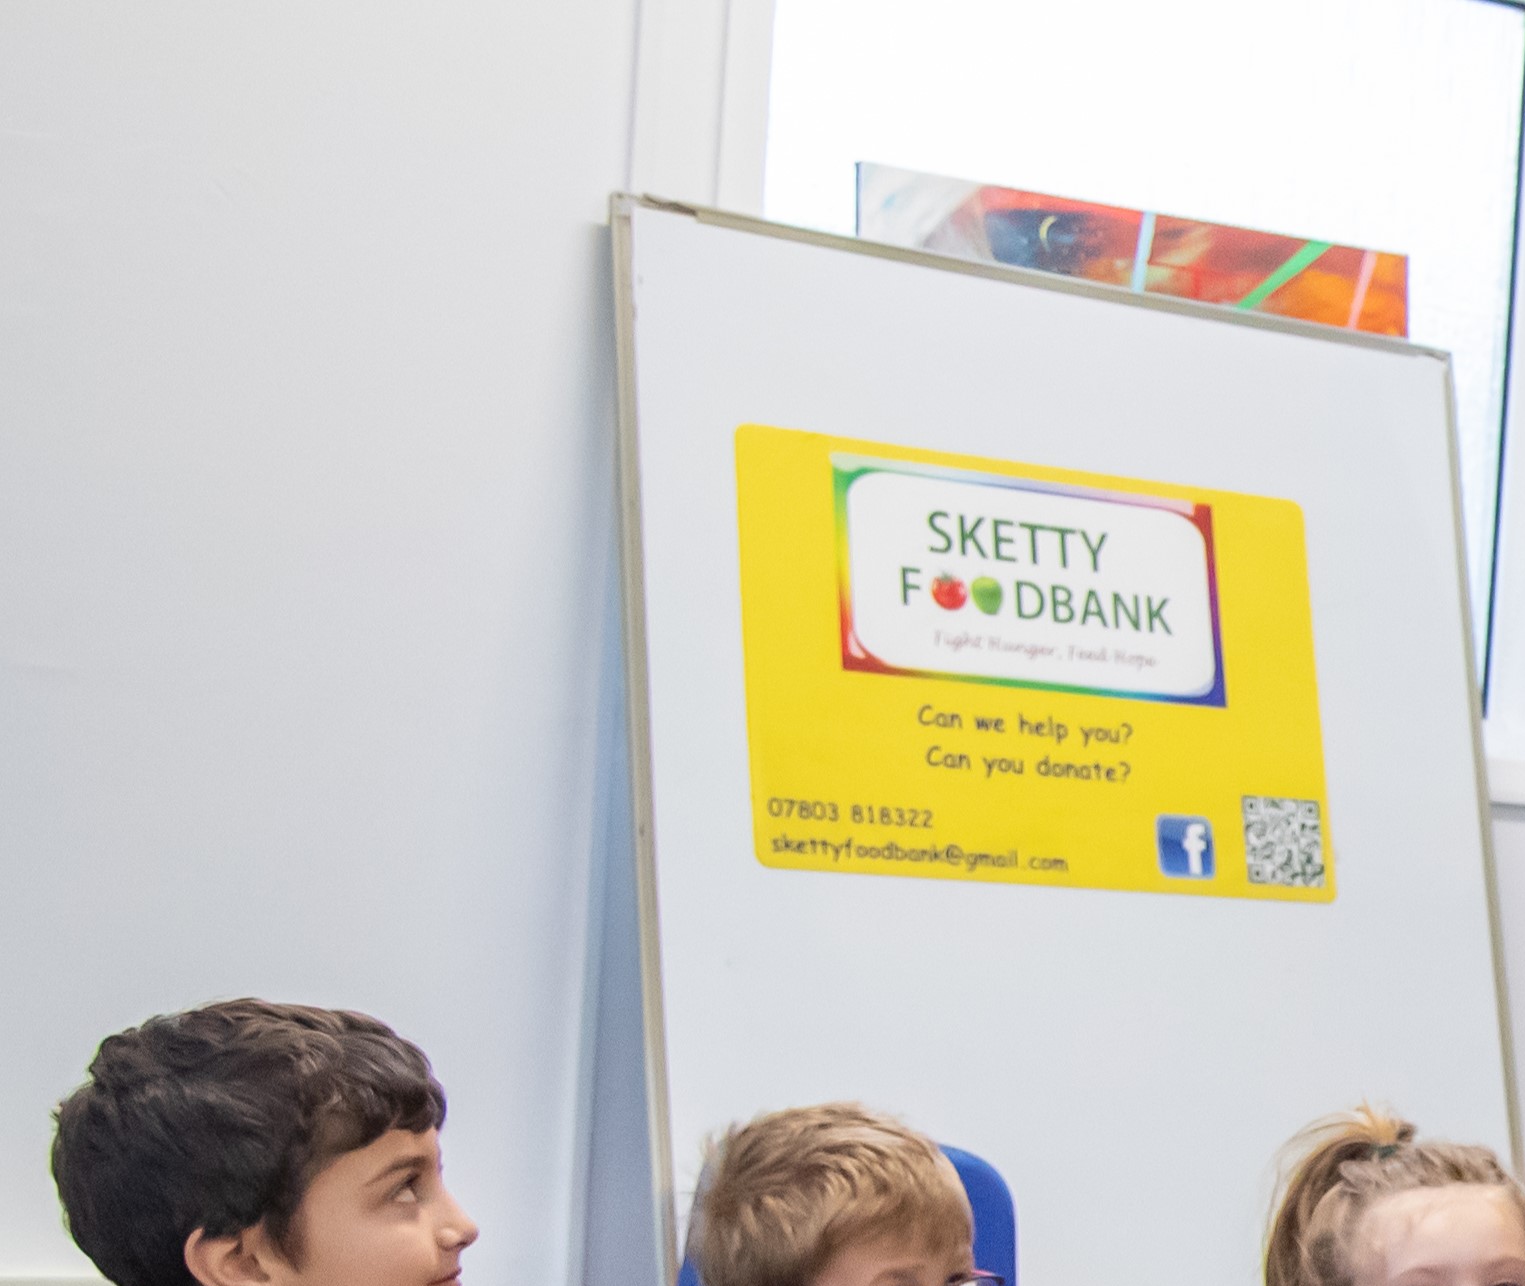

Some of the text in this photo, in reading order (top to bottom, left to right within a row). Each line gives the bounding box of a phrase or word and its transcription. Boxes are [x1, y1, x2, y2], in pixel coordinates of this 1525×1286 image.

[927, 510, 1108, 572] SKETTY
[917, 704, 1133, 748] Can we help you?
[926, 745, 1132, 784] Can you donate?
[767, 796, 934, 829] 07803 818322
